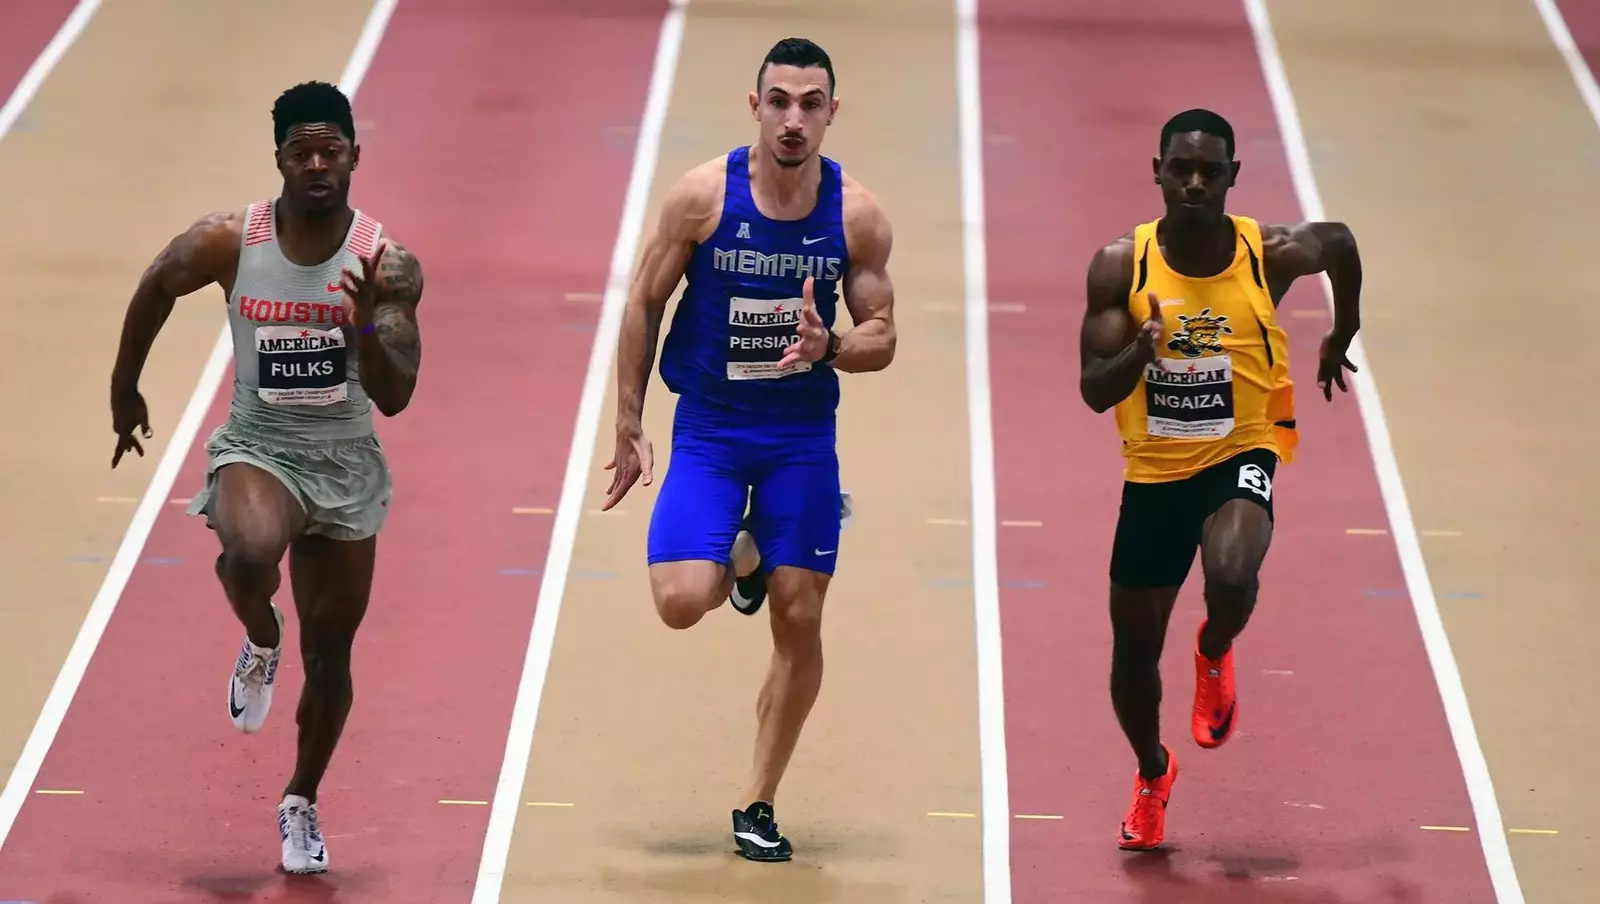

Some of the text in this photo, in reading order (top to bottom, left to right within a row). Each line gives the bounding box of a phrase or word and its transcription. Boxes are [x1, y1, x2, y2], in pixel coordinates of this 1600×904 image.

[713, 247, 842, 280] MEMPHIS
[240, 296, 346, 325] HOUSTO
[732, 309, 802, 325] AMERICA
[260, 337, 339, 351] AMERICAN
[271, 360, 334, 377] FULKS
[1148, 369, 1226, 384] AMERICAN
[1153, 393, 1225, 409] NGAIZA
[1244, 466, 1266, 493] 3
